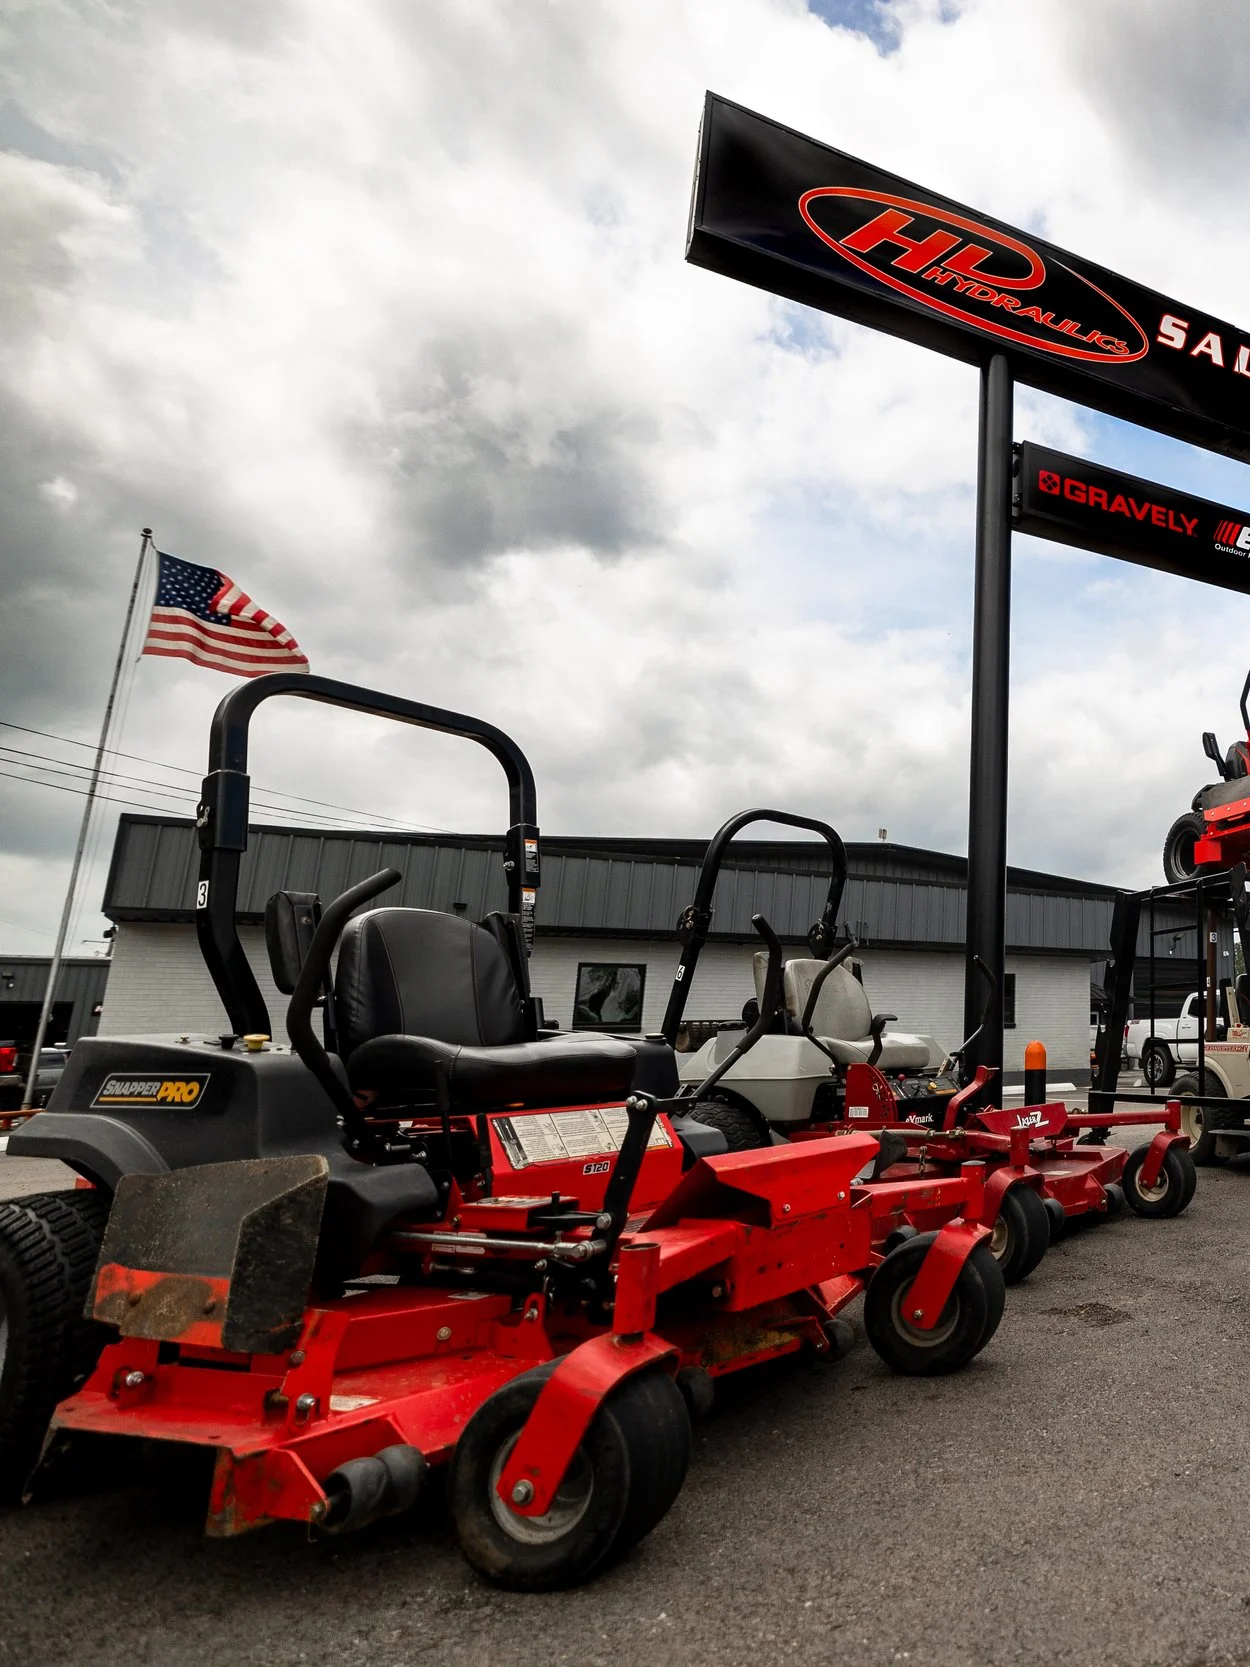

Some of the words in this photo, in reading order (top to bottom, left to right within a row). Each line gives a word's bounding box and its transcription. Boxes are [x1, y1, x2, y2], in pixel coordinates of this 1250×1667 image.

[922, 265, 1131, 356] HYDRAULICS
[1064, 478, 1199, 536] GRAVELY
[1214, 543, 1247, 557] Outdoor
[198, 883, 207, 907] 3
[103, 1080, 161, 1095] SNAPPER
[156, 1081, 200, 1102] PRO
[584, 1162, 609, 1175] S120
